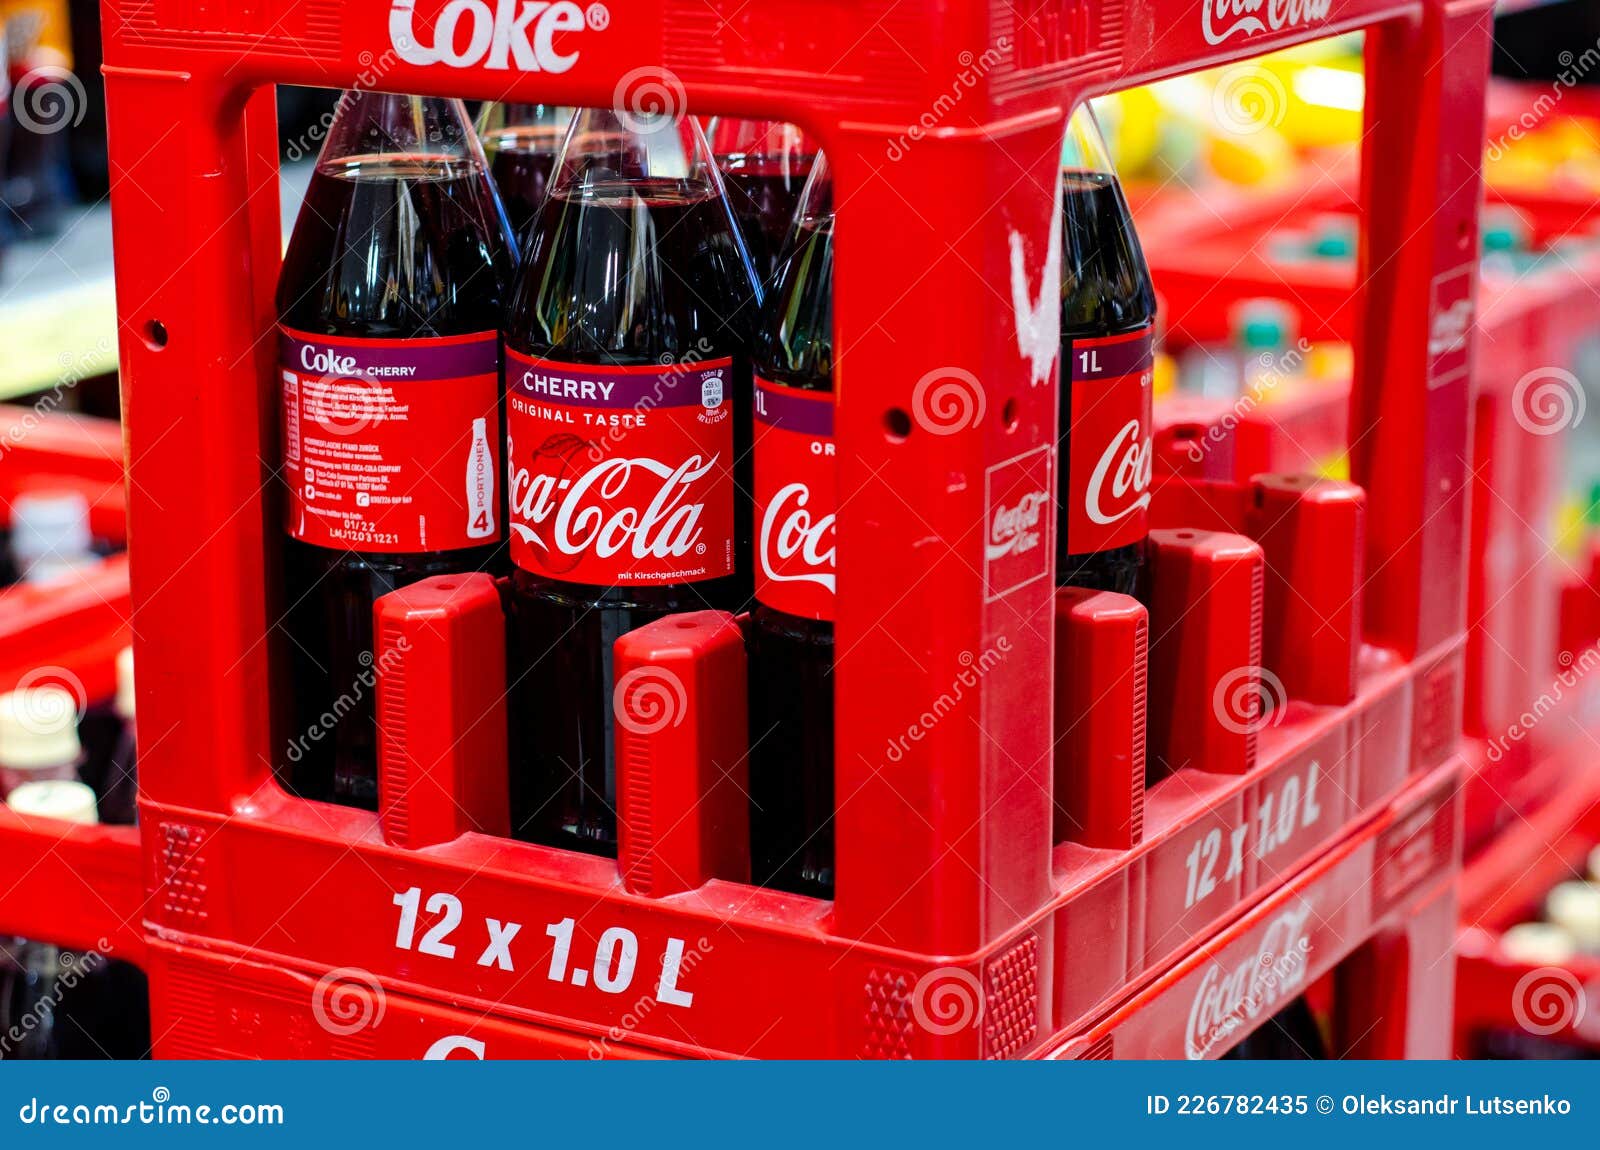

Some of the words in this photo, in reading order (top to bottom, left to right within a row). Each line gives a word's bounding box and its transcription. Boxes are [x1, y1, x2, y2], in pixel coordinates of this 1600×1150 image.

[366, 366, 416, 376] CHERRY
[1079, 351, 1102, 373] 1L
[523, 371, 615, 401] CHERRY
[511, 398, 575, 424] ORIGINAL
[583, 413, 646, 427] TASTE
[476, 437, 484, 507] PORTIONEN
[472, 510, 489, 532] 4
[618, 571, 632, 580] mit
[634, 566, 706, 581] Kirschgeschmack
[1185, 827, 1222, 909] 12
[1224, 823, 1249, 883] x
[1257, 775, 1299, 860] 1.0
[1302, 761, 1321, 828] L
[392, 886, 463, 959] 12
[476, 917, 522, 972] x
[546, 917, 638, 994] 1.0
[656, 937, 694, 1008] L
